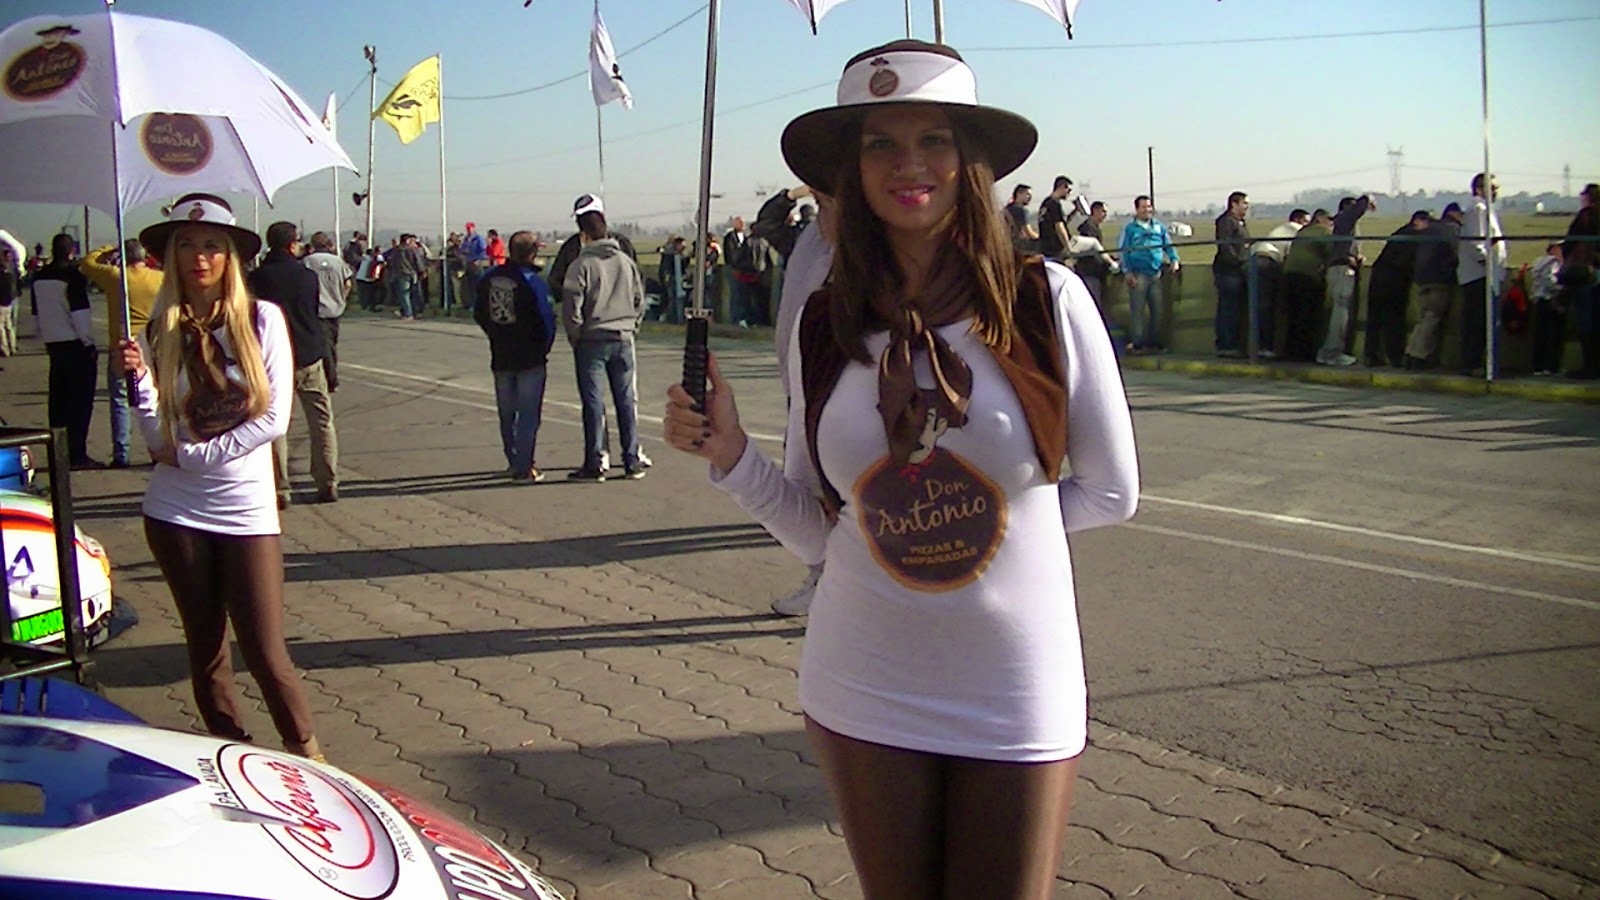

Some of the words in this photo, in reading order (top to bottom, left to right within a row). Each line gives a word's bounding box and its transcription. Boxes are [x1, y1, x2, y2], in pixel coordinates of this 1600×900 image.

[925, 479, 969, 501] Don
[876, 496, 987, 537] Antonio
[910, 542, 952, 554] PIZZAS
